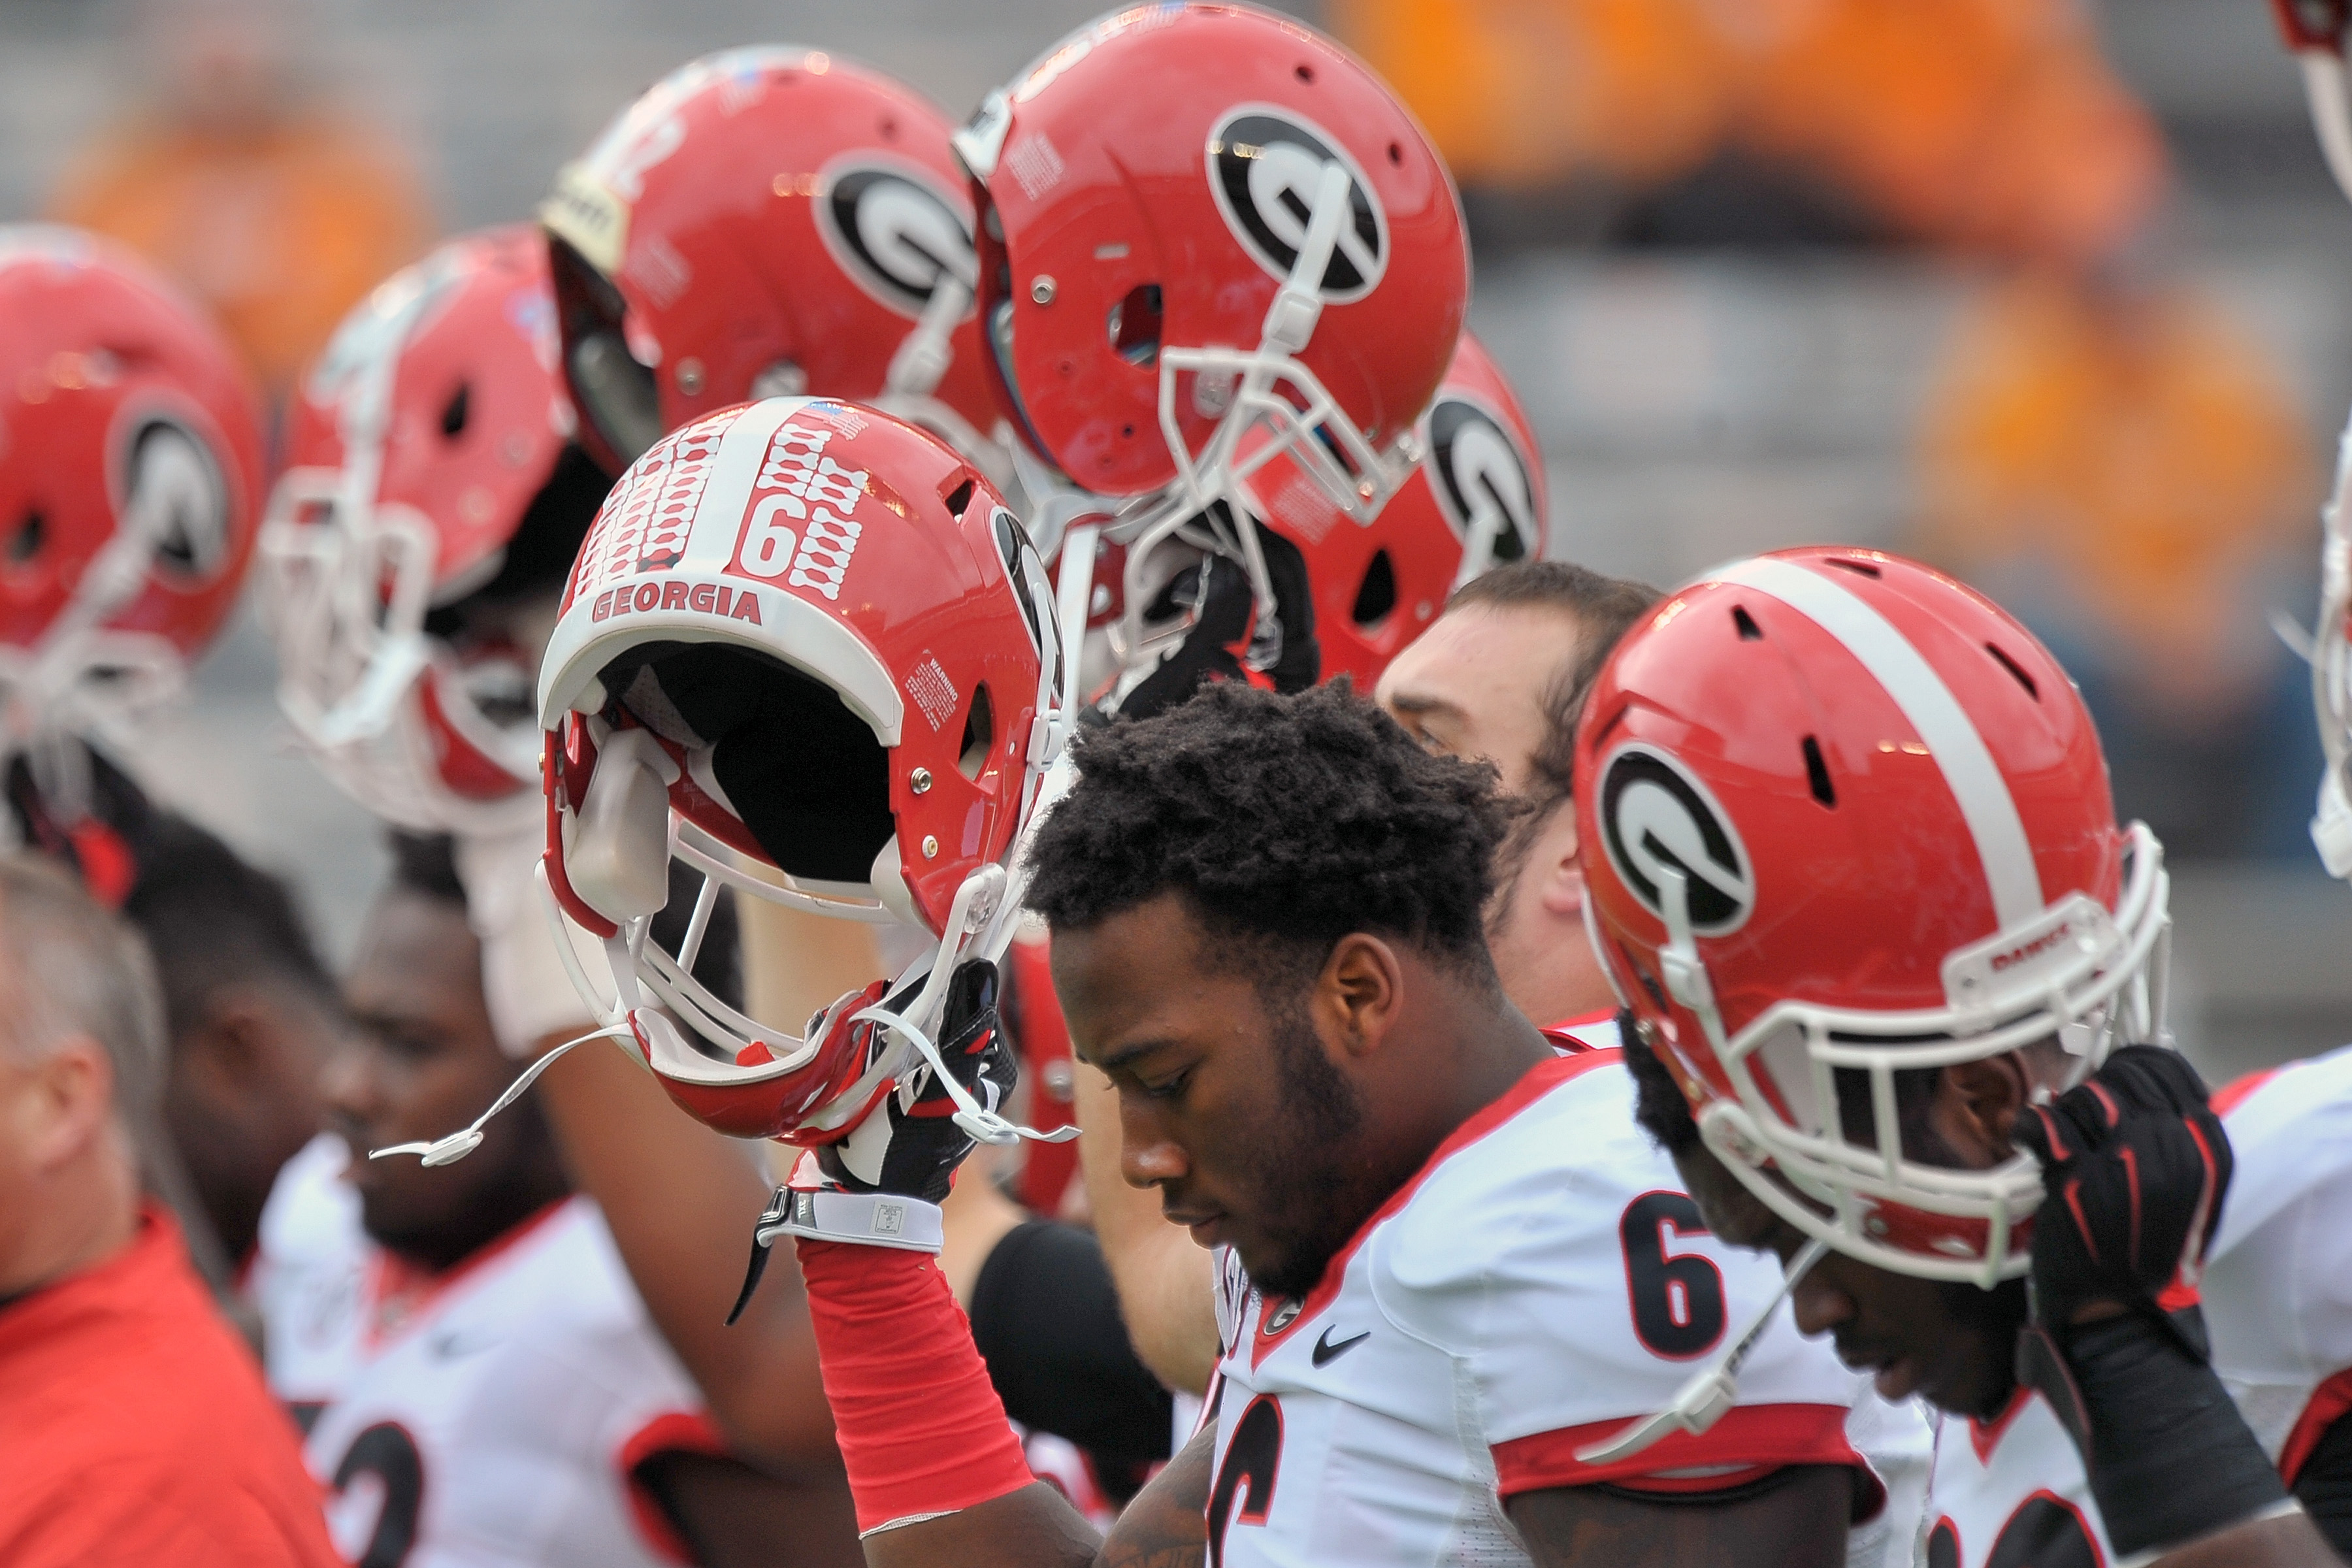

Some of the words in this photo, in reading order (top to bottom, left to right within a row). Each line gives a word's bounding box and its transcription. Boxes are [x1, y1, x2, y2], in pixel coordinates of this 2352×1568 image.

[740, 494, 807, 578] 6
[592, 581, 763, 627] GEORGIA
[930, 657, 958, 702] WARNING
[1619, 1190, 1729, 1361] 6
